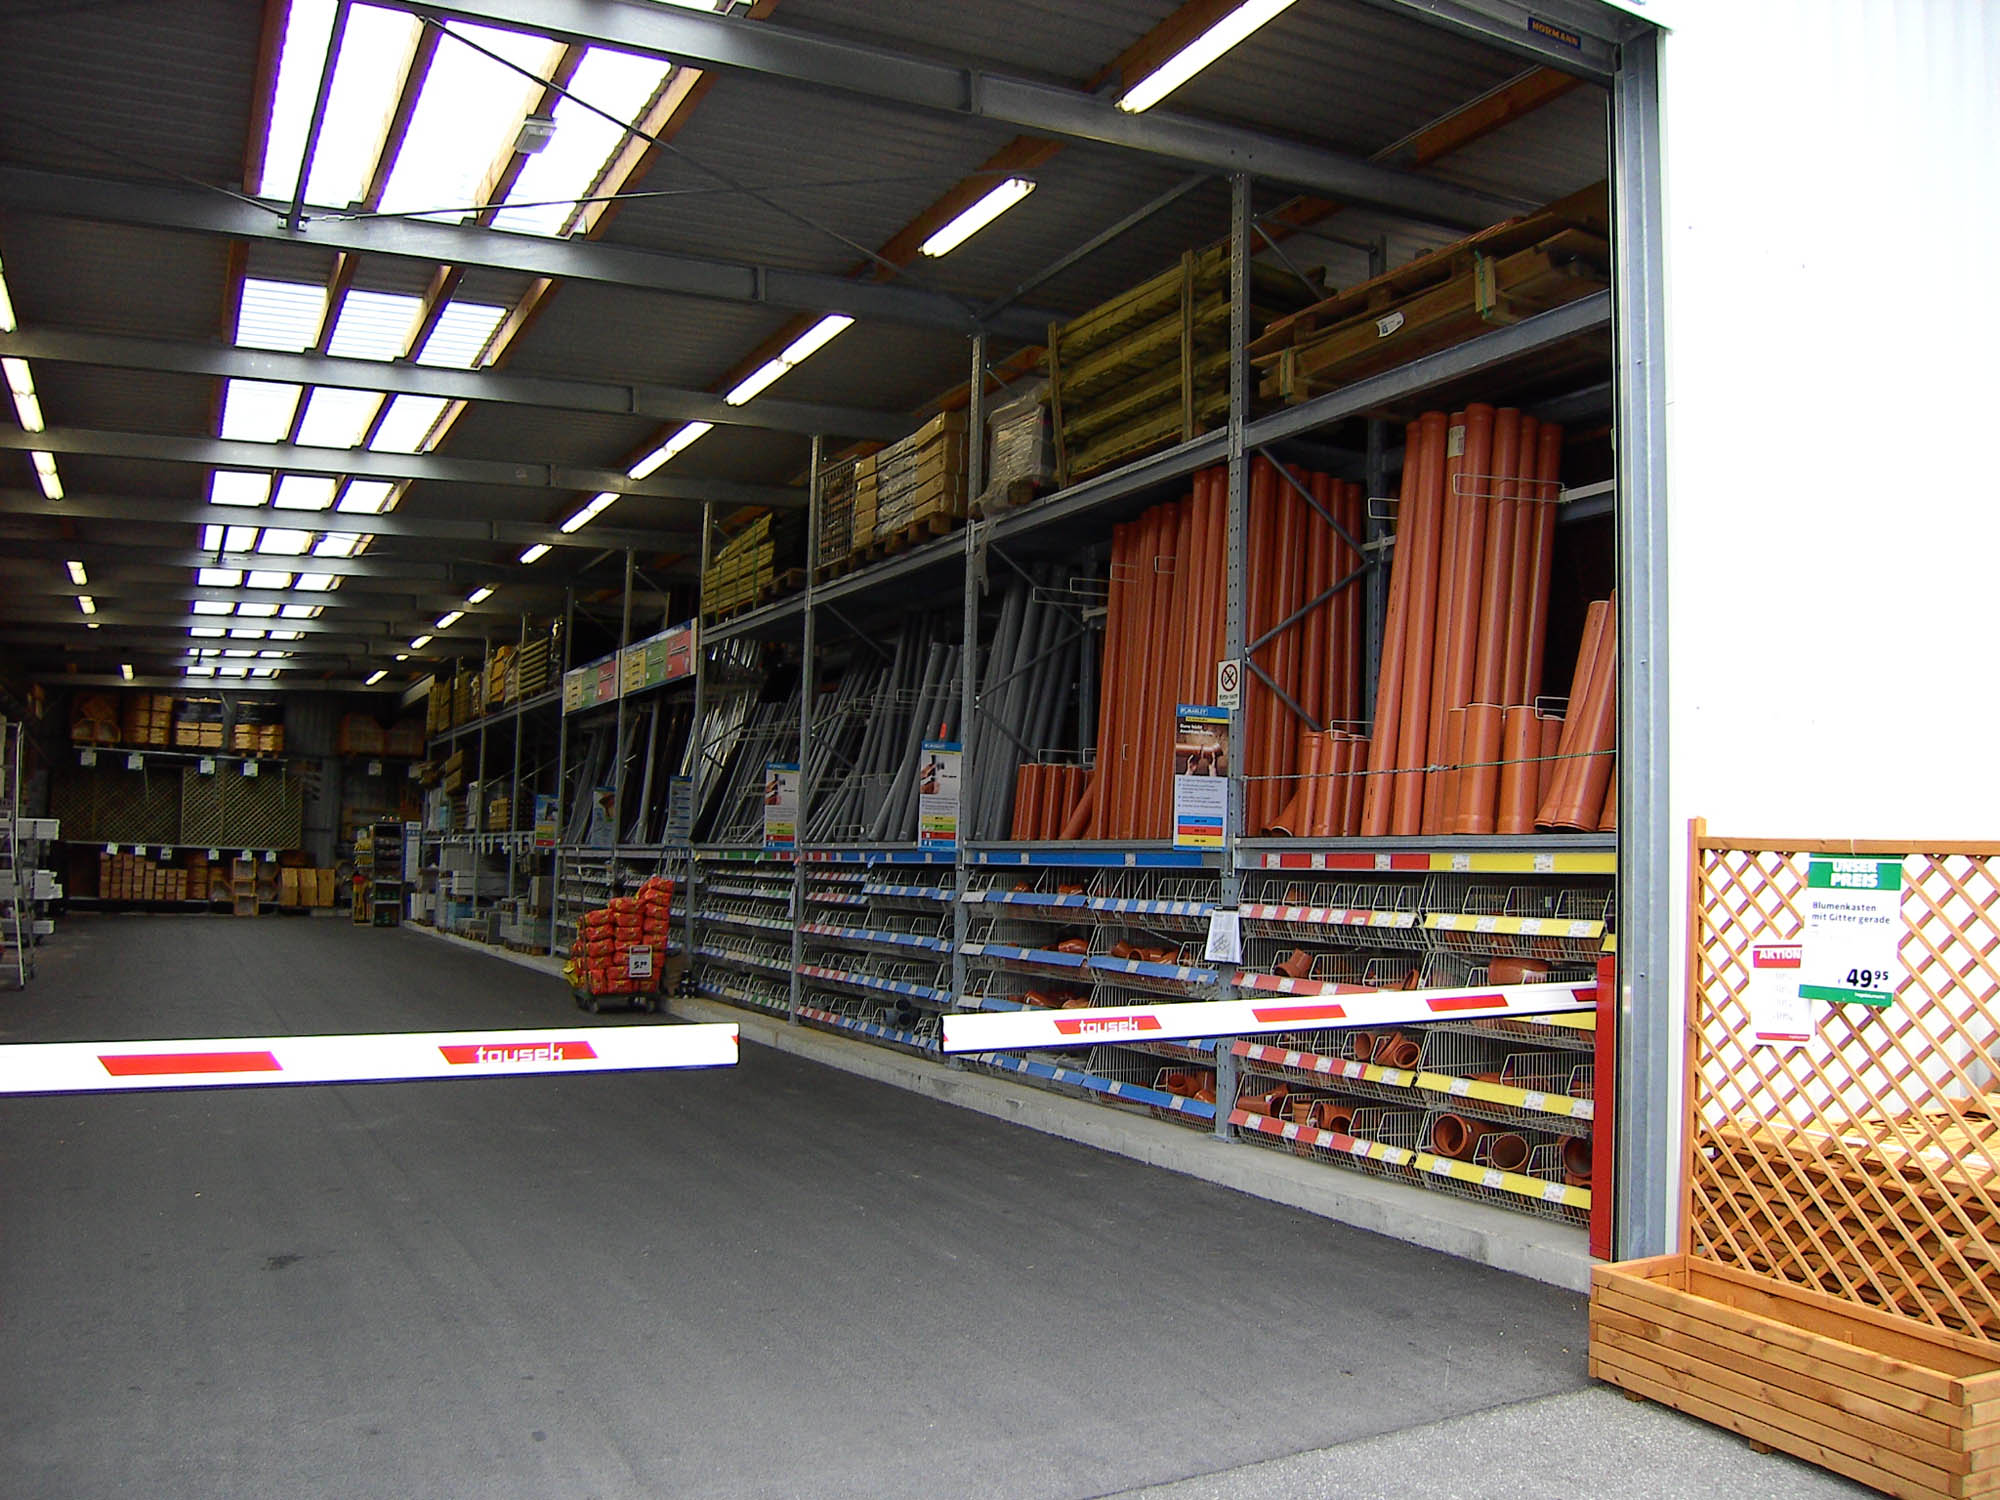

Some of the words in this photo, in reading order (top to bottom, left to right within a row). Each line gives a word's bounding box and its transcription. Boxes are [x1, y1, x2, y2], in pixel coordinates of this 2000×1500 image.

[1830, 872, 1878, 888] PREIS
[1812, 901, 1876, 911] Blumenkasten
[1812, 913, 1827, 921] mit
[1829, 913, 1856, 921] Gitter
[1858, 915, 1890, 925] gerade
[1759, 949, 1801, 960] AKTION
[1078, 1016, 1139, 1034] tousek
[474, 1042, 564, 1064] tousek
